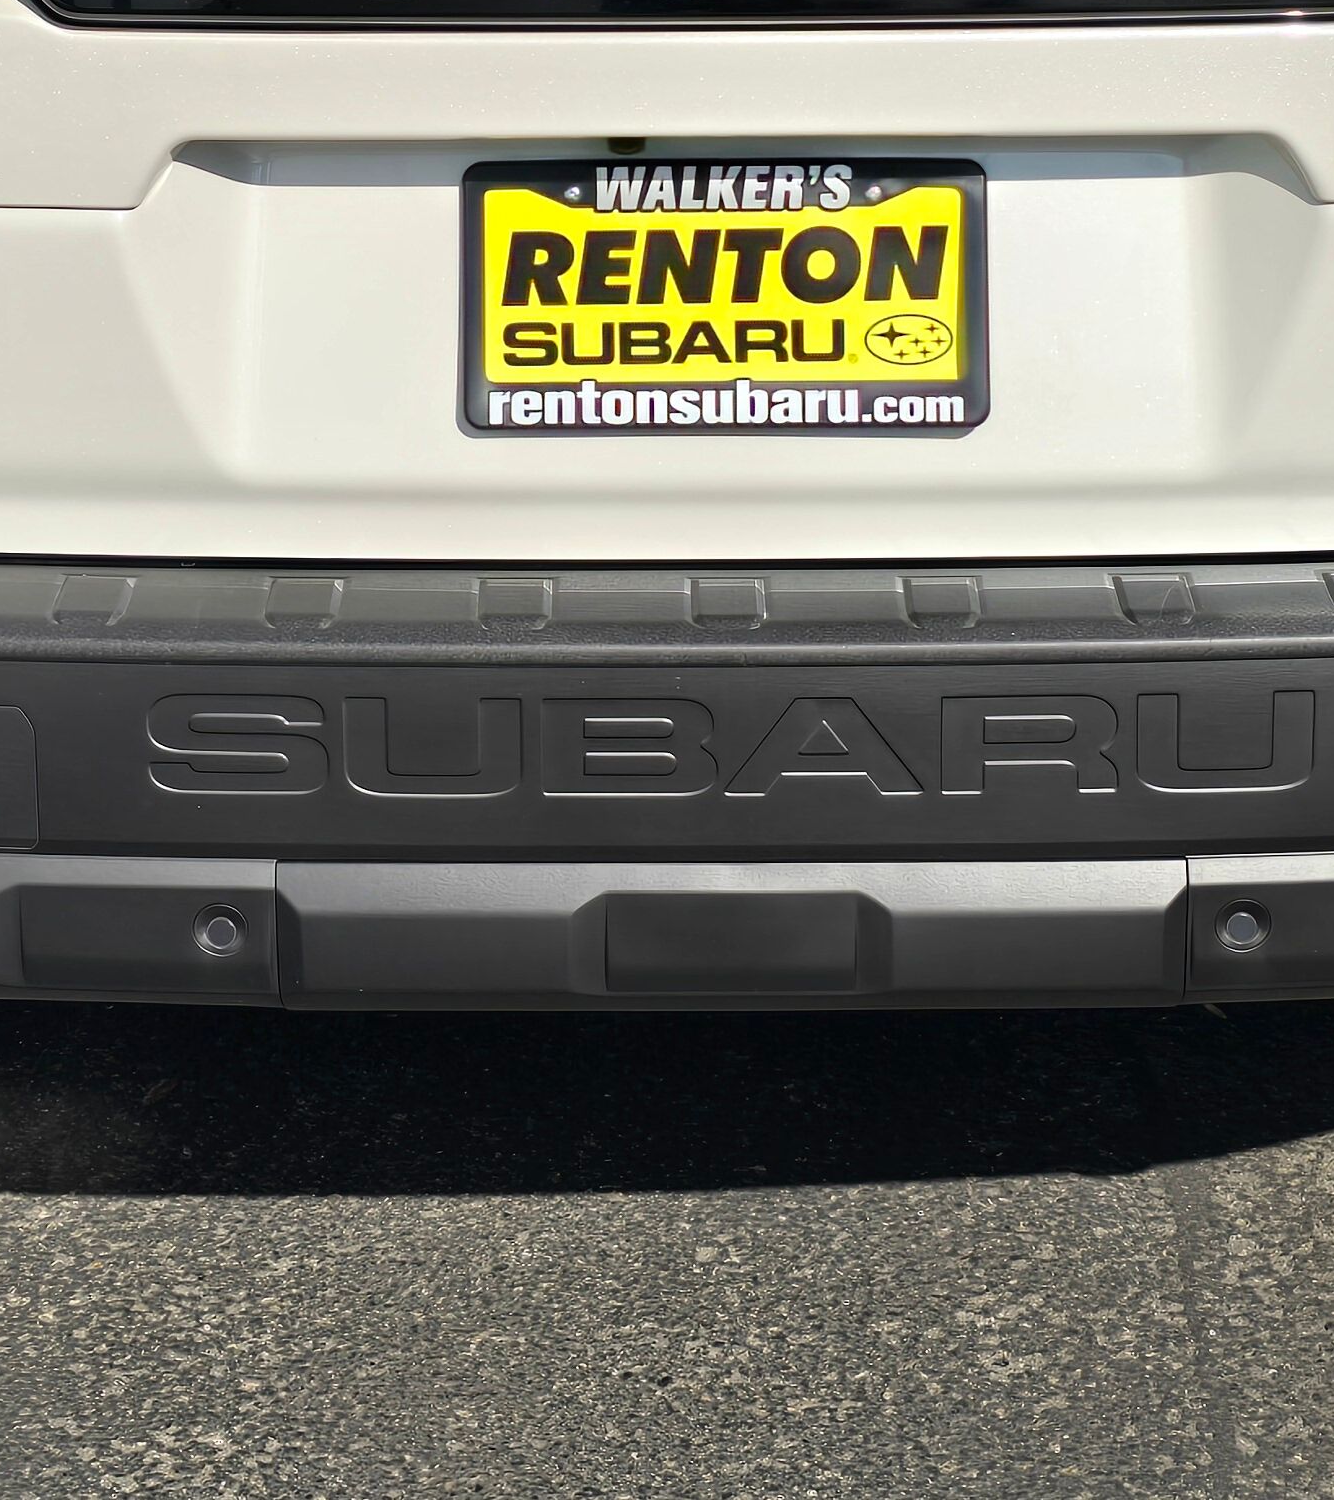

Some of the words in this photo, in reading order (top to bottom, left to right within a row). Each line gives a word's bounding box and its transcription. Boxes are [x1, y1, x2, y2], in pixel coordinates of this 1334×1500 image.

[595, 165, 852, 212] WALKER'S
[501, 225, 949, 307] RENTON
[502, 318, 846, 367] SUBARU
[487, 379, 965, 426] rentonsubaru.com
[146, 689, 1316, 798] SUBARU
